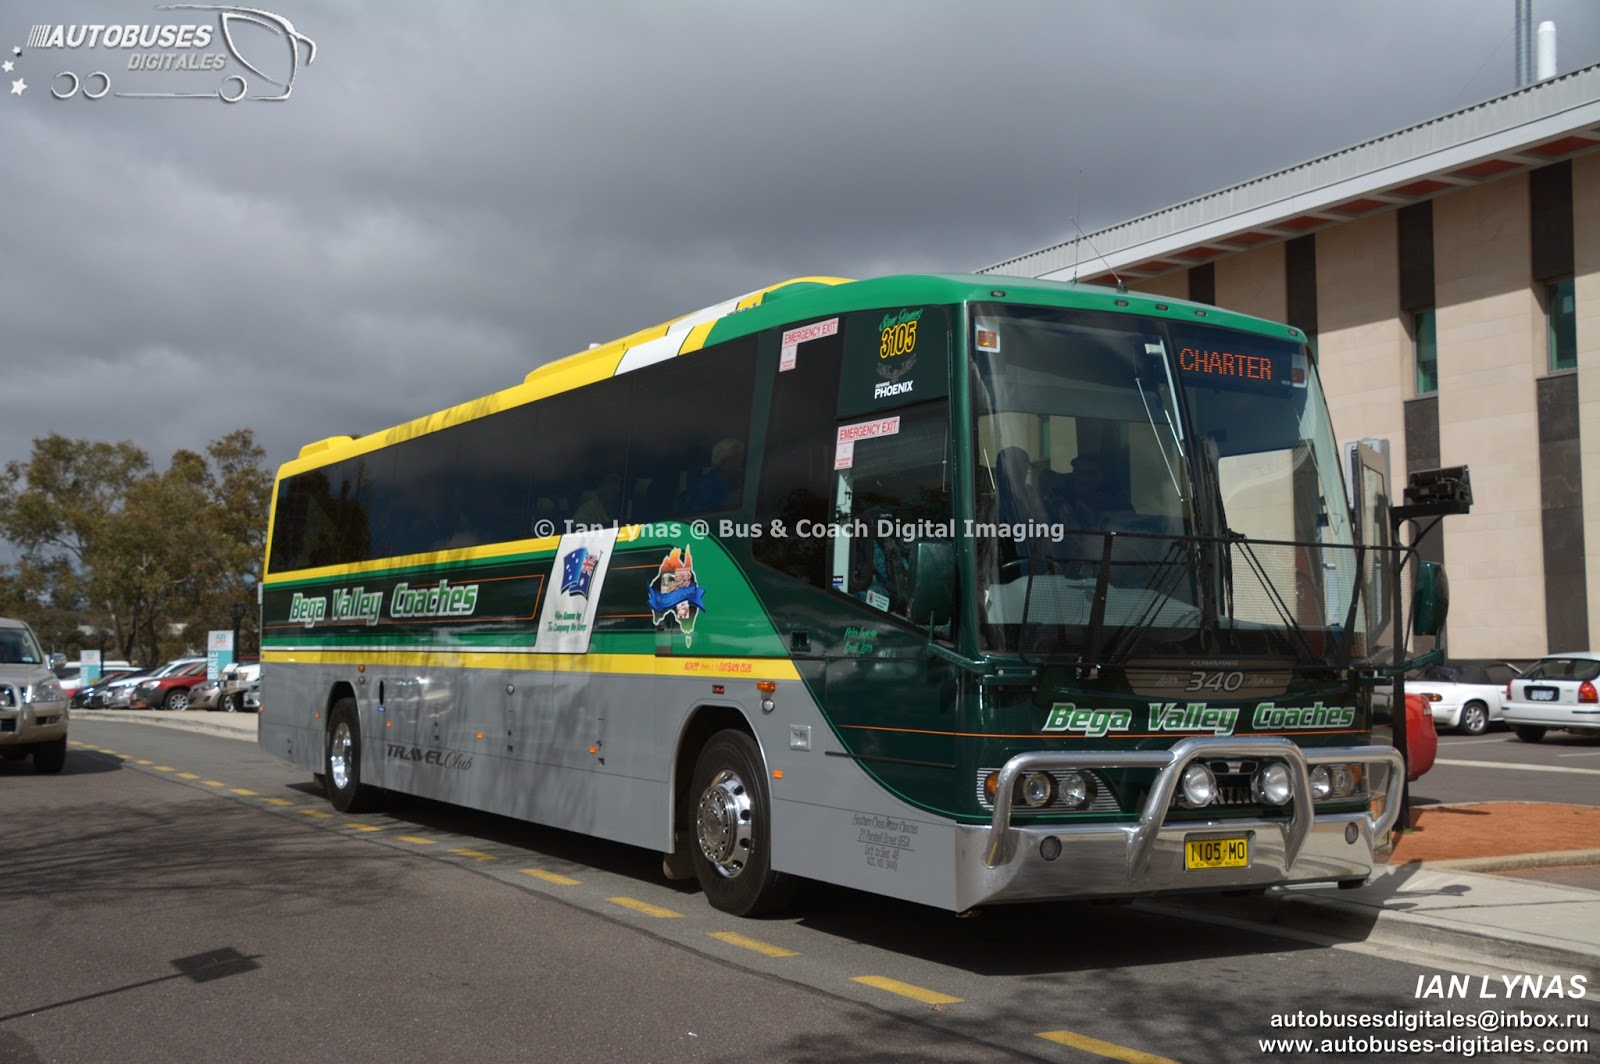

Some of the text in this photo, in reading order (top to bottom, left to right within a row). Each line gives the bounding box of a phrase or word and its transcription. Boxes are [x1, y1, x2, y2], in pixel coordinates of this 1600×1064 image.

[785, 321, 837, 344] EMERGENCY EXIT
[879, 320, 917, 359] 3105
[1179, 347, 1272, 380] CHARTER
[874, 380, 914, 399] PHOENIX
[840, 420, 898, 440] EMERGENCY EXIT
[288, 579, 479, 629] Bega Valley Coaches
[1185, 671, 1244, 693] 340
[1041, 701, 1356, 738] Bega Valley Coaches
[387, 743, 473, 771] TRAVEL Club
